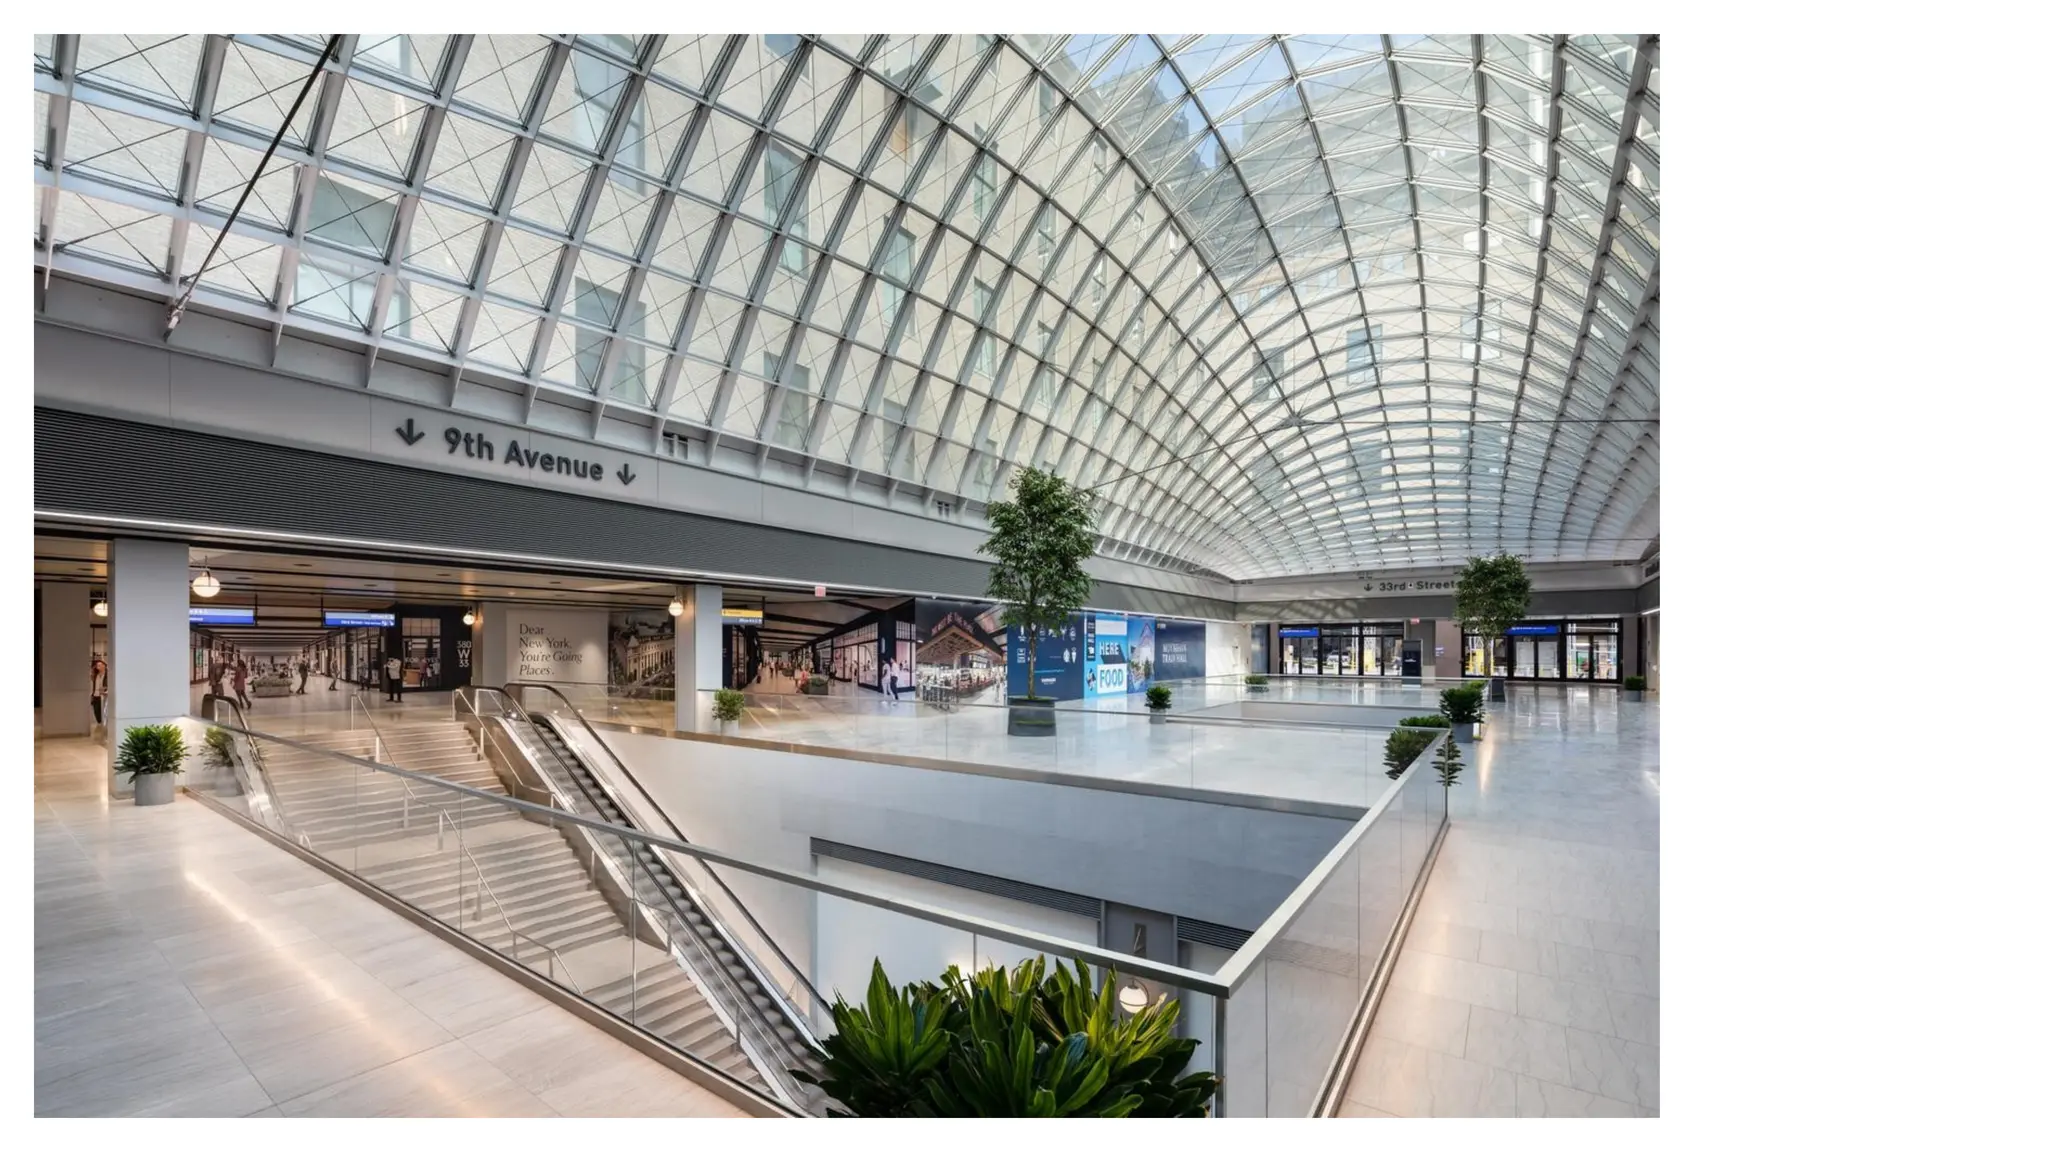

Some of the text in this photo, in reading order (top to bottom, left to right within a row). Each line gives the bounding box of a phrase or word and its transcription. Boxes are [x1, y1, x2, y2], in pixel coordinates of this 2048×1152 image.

[444, 427, 604, 481] 9th Avenue
[1379, 580, 1455, 591] 33rd Street
[520, 623, 544, 635] Dear
[519, 637, 544, 648] New
[1100, 641, 1120, 655] HERE
[457, 650, 470, 659] W
[553, 651, 583, 664] Going
[459, 660, 469, 668] 33
[1100, 667, 1124, 688] FOOD
